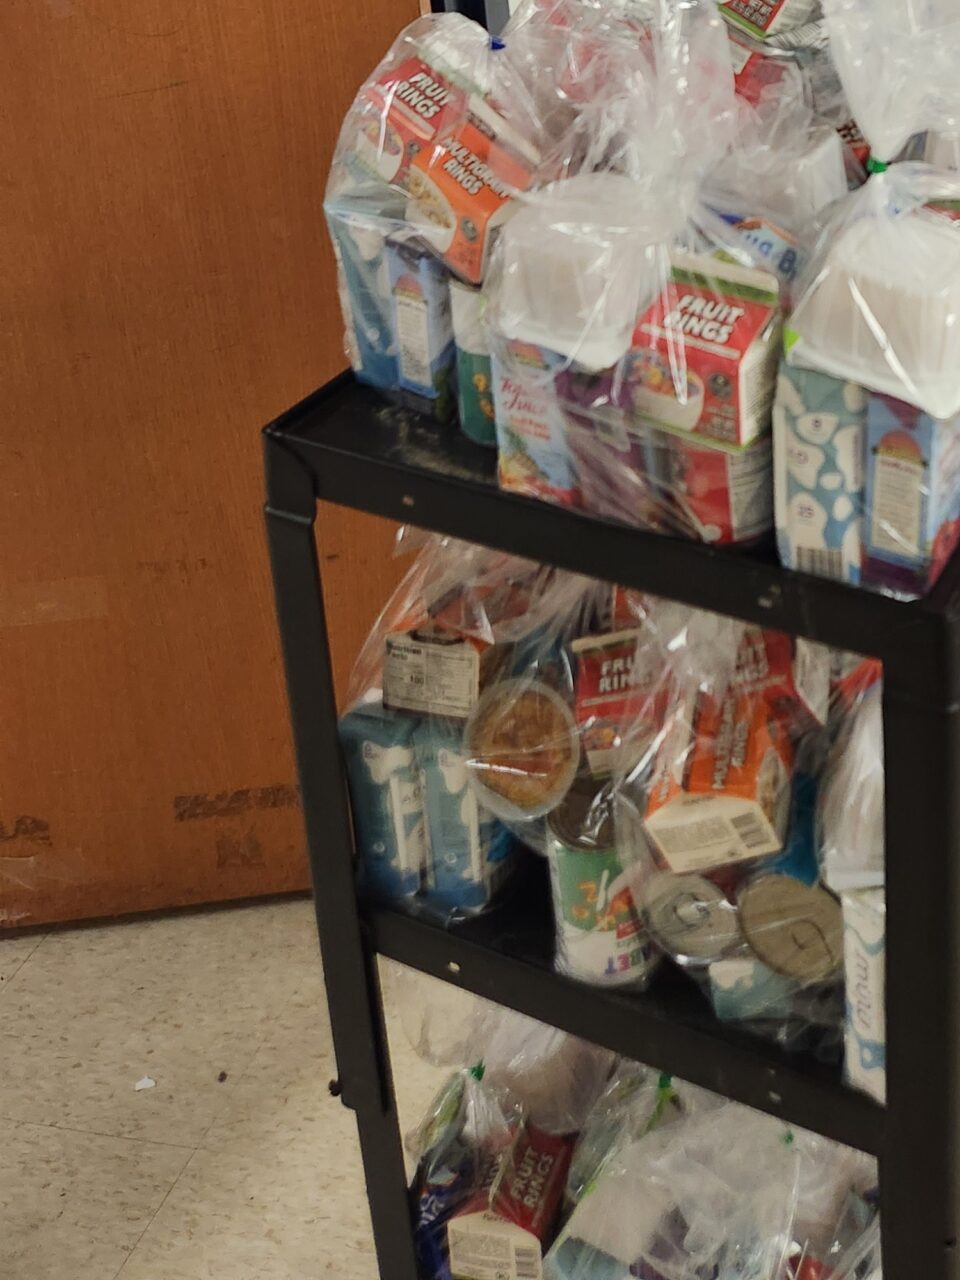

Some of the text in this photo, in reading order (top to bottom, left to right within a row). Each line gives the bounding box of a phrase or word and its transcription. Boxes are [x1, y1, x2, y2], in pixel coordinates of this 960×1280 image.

[397, 82, 441, 119] RINGS
[408, 72, 456, 107] FRUIT
[443, 159, 483, 196] RINGS
[676, 294, 745, 322] FRUIT
[664, 310, 733, 345] RINGS
[510, 1145, 539, 1200] FRUIT
[523, 1151, 554, 1209] RINGS
